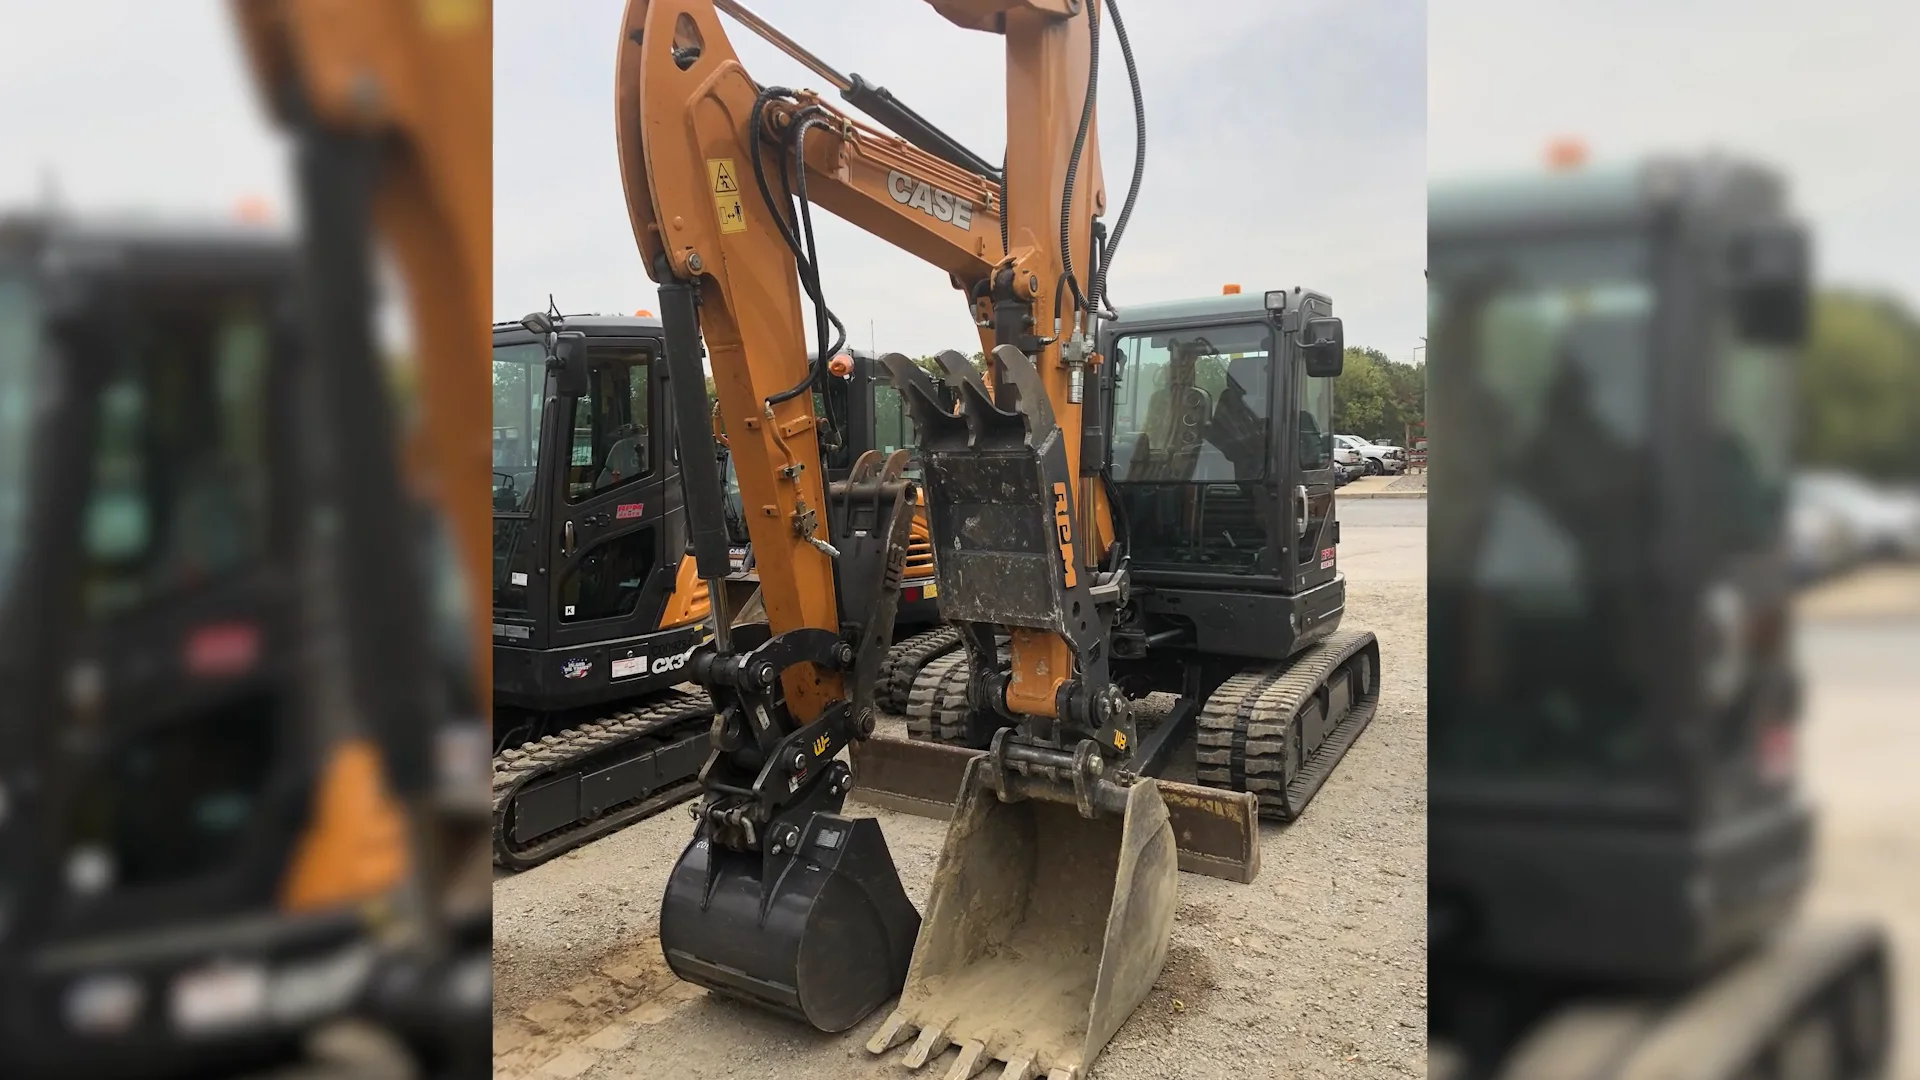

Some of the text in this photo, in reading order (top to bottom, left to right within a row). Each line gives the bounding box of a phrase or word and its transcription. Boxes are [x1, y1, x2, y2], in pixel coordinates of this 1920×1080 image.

[887, 169, 974, 232] CASE
[617, 504, 643, 512] RPM
[1052, 481, 1077, 588] RPM
